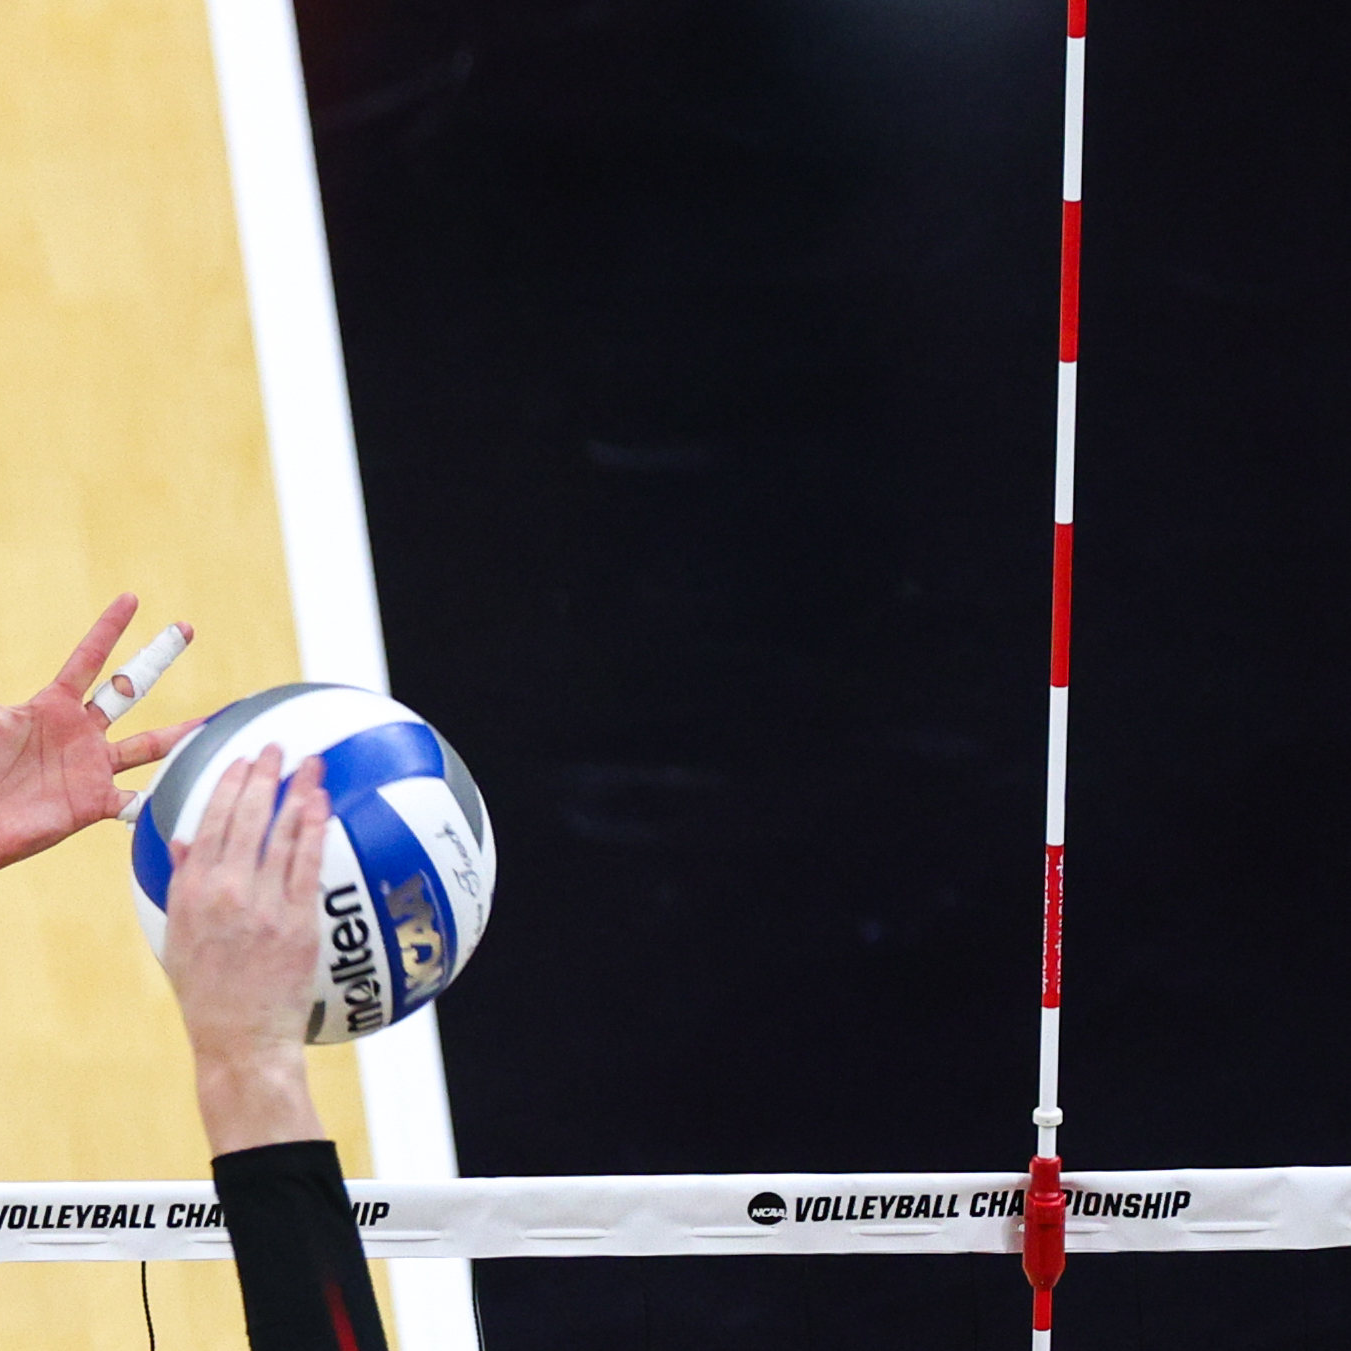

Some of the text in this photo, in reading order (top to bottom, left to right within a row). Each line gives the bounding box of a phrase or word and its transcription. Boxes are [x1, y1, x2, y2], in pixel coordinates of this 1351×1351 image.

[324, 882, 384, 1034] molten
[752, 1207, 786, 1218] NCAA
[795, 1193, 960, 1223] VOLLEYBALL
